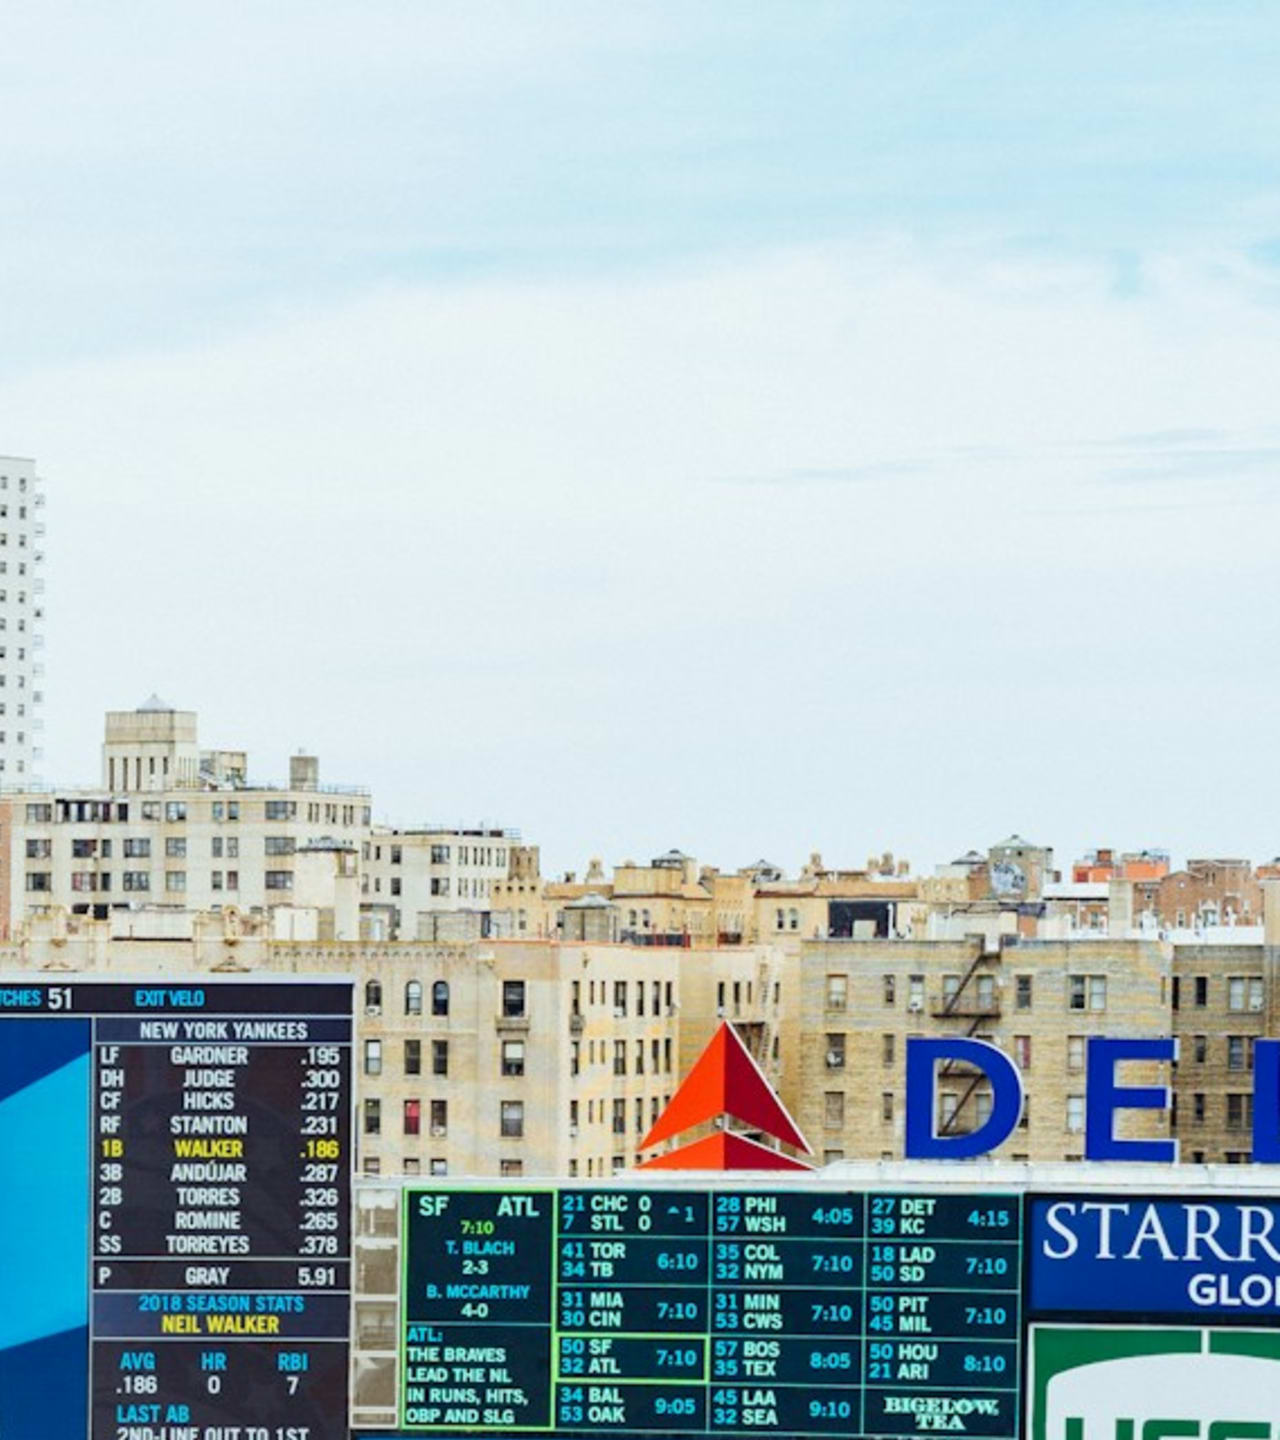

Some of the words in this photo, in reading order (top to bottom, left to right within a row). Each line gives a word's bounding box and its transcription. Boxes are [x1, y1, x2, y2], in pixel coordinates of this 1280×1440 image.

[47, 987, 72, 1009] 51
[140, 1023, 178, 1039] NEW
[184, 1023, 227, 1039] YORK
[234, 1023, 308, 1039] YANKEES
[170, 1048, 248, 1064] GARDNER
[183, 1070, 235, 1087] JUDGE
[183, 1092, 234, 1110] HICKS
[906, 1036, 1280, 1163] DE
[170, 1116, 247, 1133] STANTON
[175, 1141, 243, 1157] WALKER
[170, 1161, 247, 1182] ANDÚJAR
[177, 1188, 240, 1205] TORRES
[419, 1196, 449, 1216] SF
[497, 1197, 539, 1216] ATL
[175, 1212, 240, 1229] ROMINE
[1042, 1201, 1280, 1262] STARR
[166, 1235, 249, 1253] TORREYES
[462, 1241, 515, 1255] BLACH
[185, 1267, 230, 1285] GRAY
[446, 1285, 530, 1299] MCCARTHY
[1188, 1273, 1280, 1307] GLO
[162, 1315, 201, 1333] NEIL
[207, 1315, 279, 1333] WALKER
[444, 1348, 506, 1362] BRAVES
[915, 1415, 966, 1430] TEA
